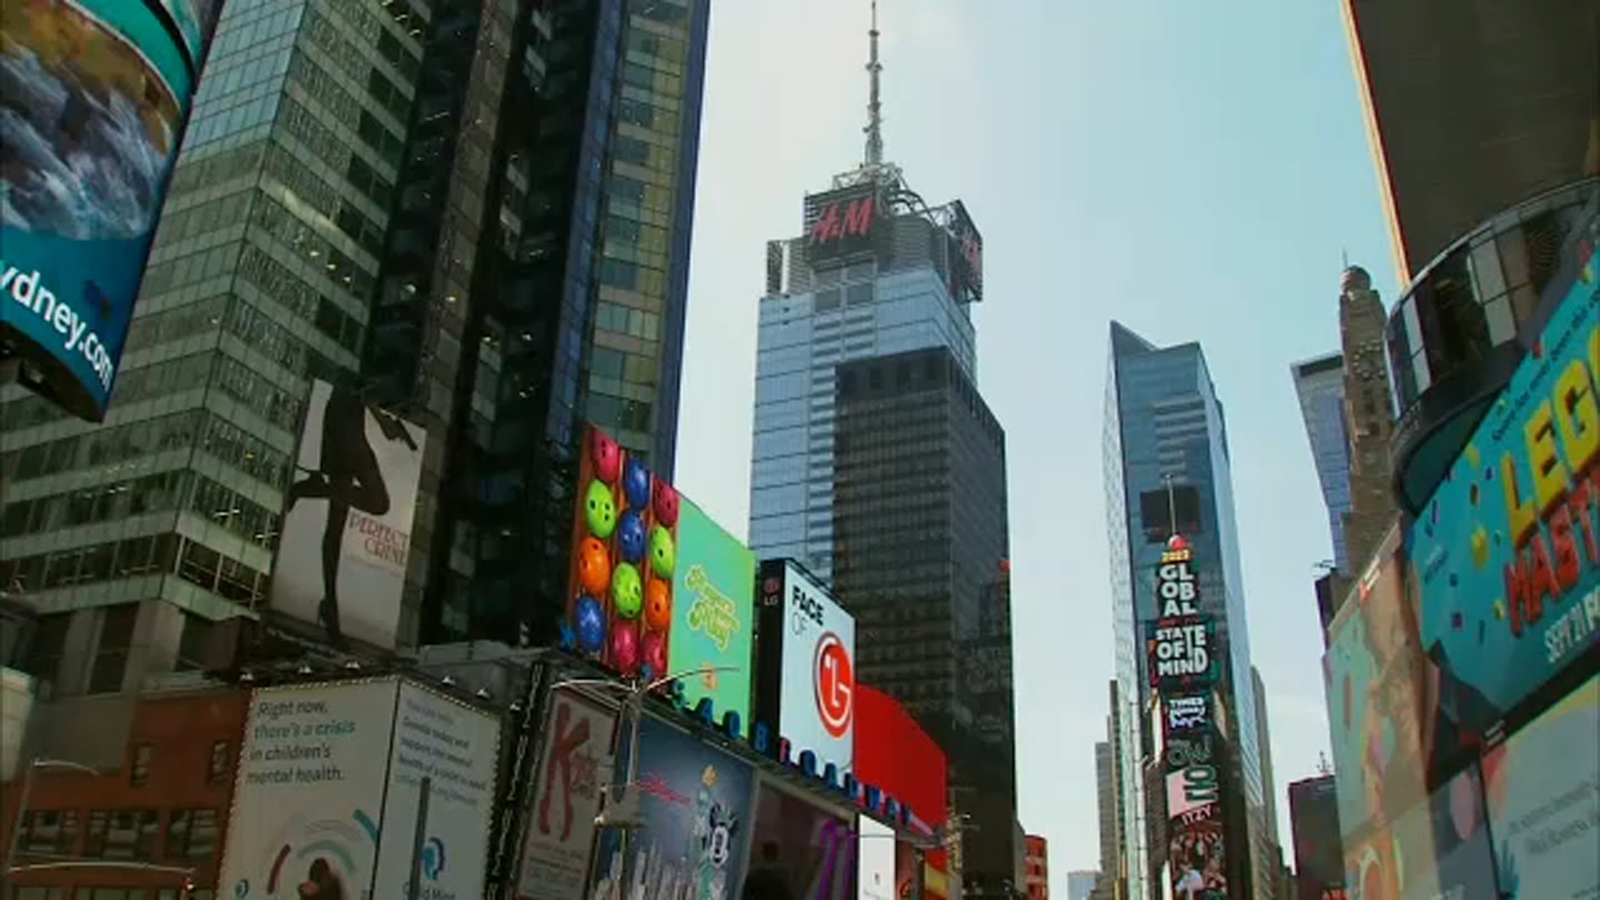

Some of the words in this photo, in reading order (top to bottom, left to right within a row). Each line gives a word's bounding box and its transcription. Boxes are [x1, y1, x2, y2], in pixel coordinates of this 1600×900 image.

[809, 199, 875, 247] H&M
[1503, 460, 1600, 641] MAST
[792, 584, 824, 627] FACE
[792, 611, 808, 636] OF
[1156, 625, 1206, 658] STATE
[1157, 641, 1185, 660] OF
[1158, 646, 1208, 677] MIND
[258, 701, 294, 720] Right
[297, 701, 329, 714] now,
[254, 721, 300, 740] there's
[302, 725, 313, 736] a
[315, 719, 356, 736] crisis
[250, 746, 262, 761] in
[265, 742, 331, 761] children's
[246, 767, 293, 785] mental
[1181, 804, 1212, 826] ITZY
